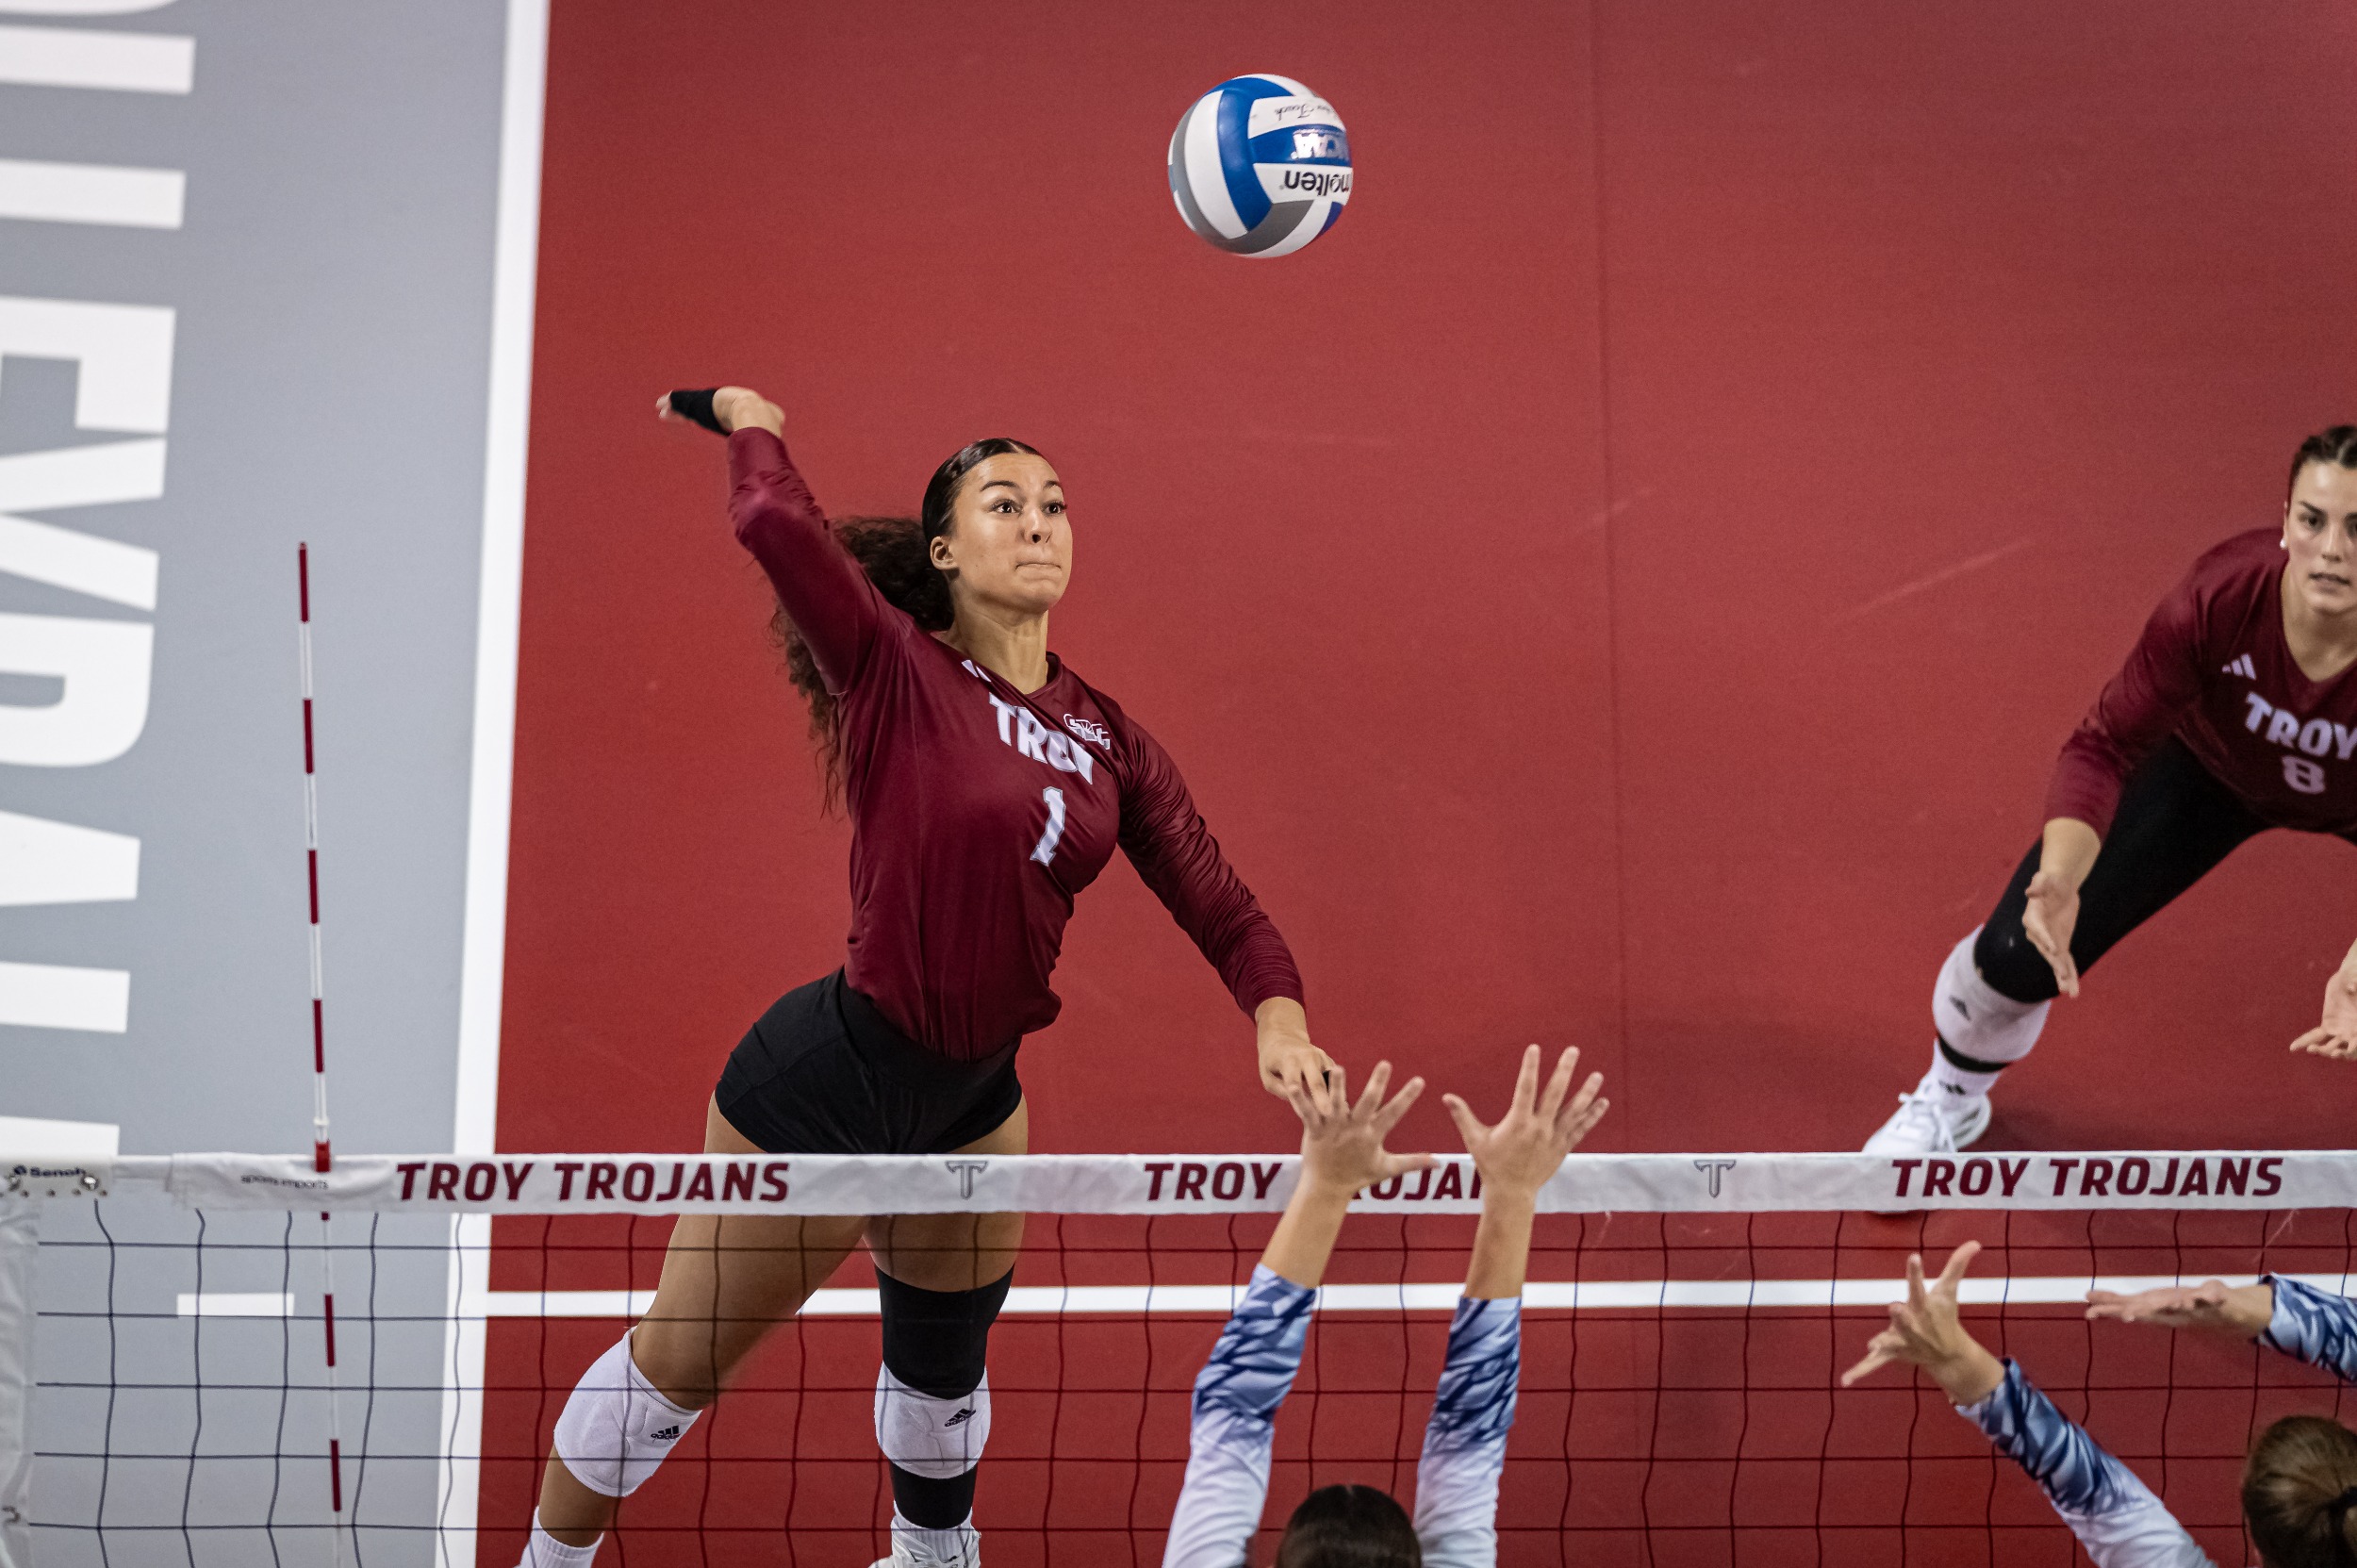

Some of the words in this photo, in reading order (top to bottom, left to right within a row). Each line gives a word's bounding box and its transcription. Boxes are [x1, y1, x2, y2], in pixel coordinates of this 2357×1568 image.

[989, 691, 1094, 785] TROY
[2245, 691, 2357, 761] TROY
[2282, 755, 2326, 795] 8
[1029, 785, 1066, 867] 1
[396, 1162, 535, 1202] TROY
[553, 1162, 790, 1202] TROJANS
[1144, 1162, 1283, 1201] TROY
[1891, 1157, 2030, 1197] TROY
[2049, 1157, 2284, 1197] TROJANS
